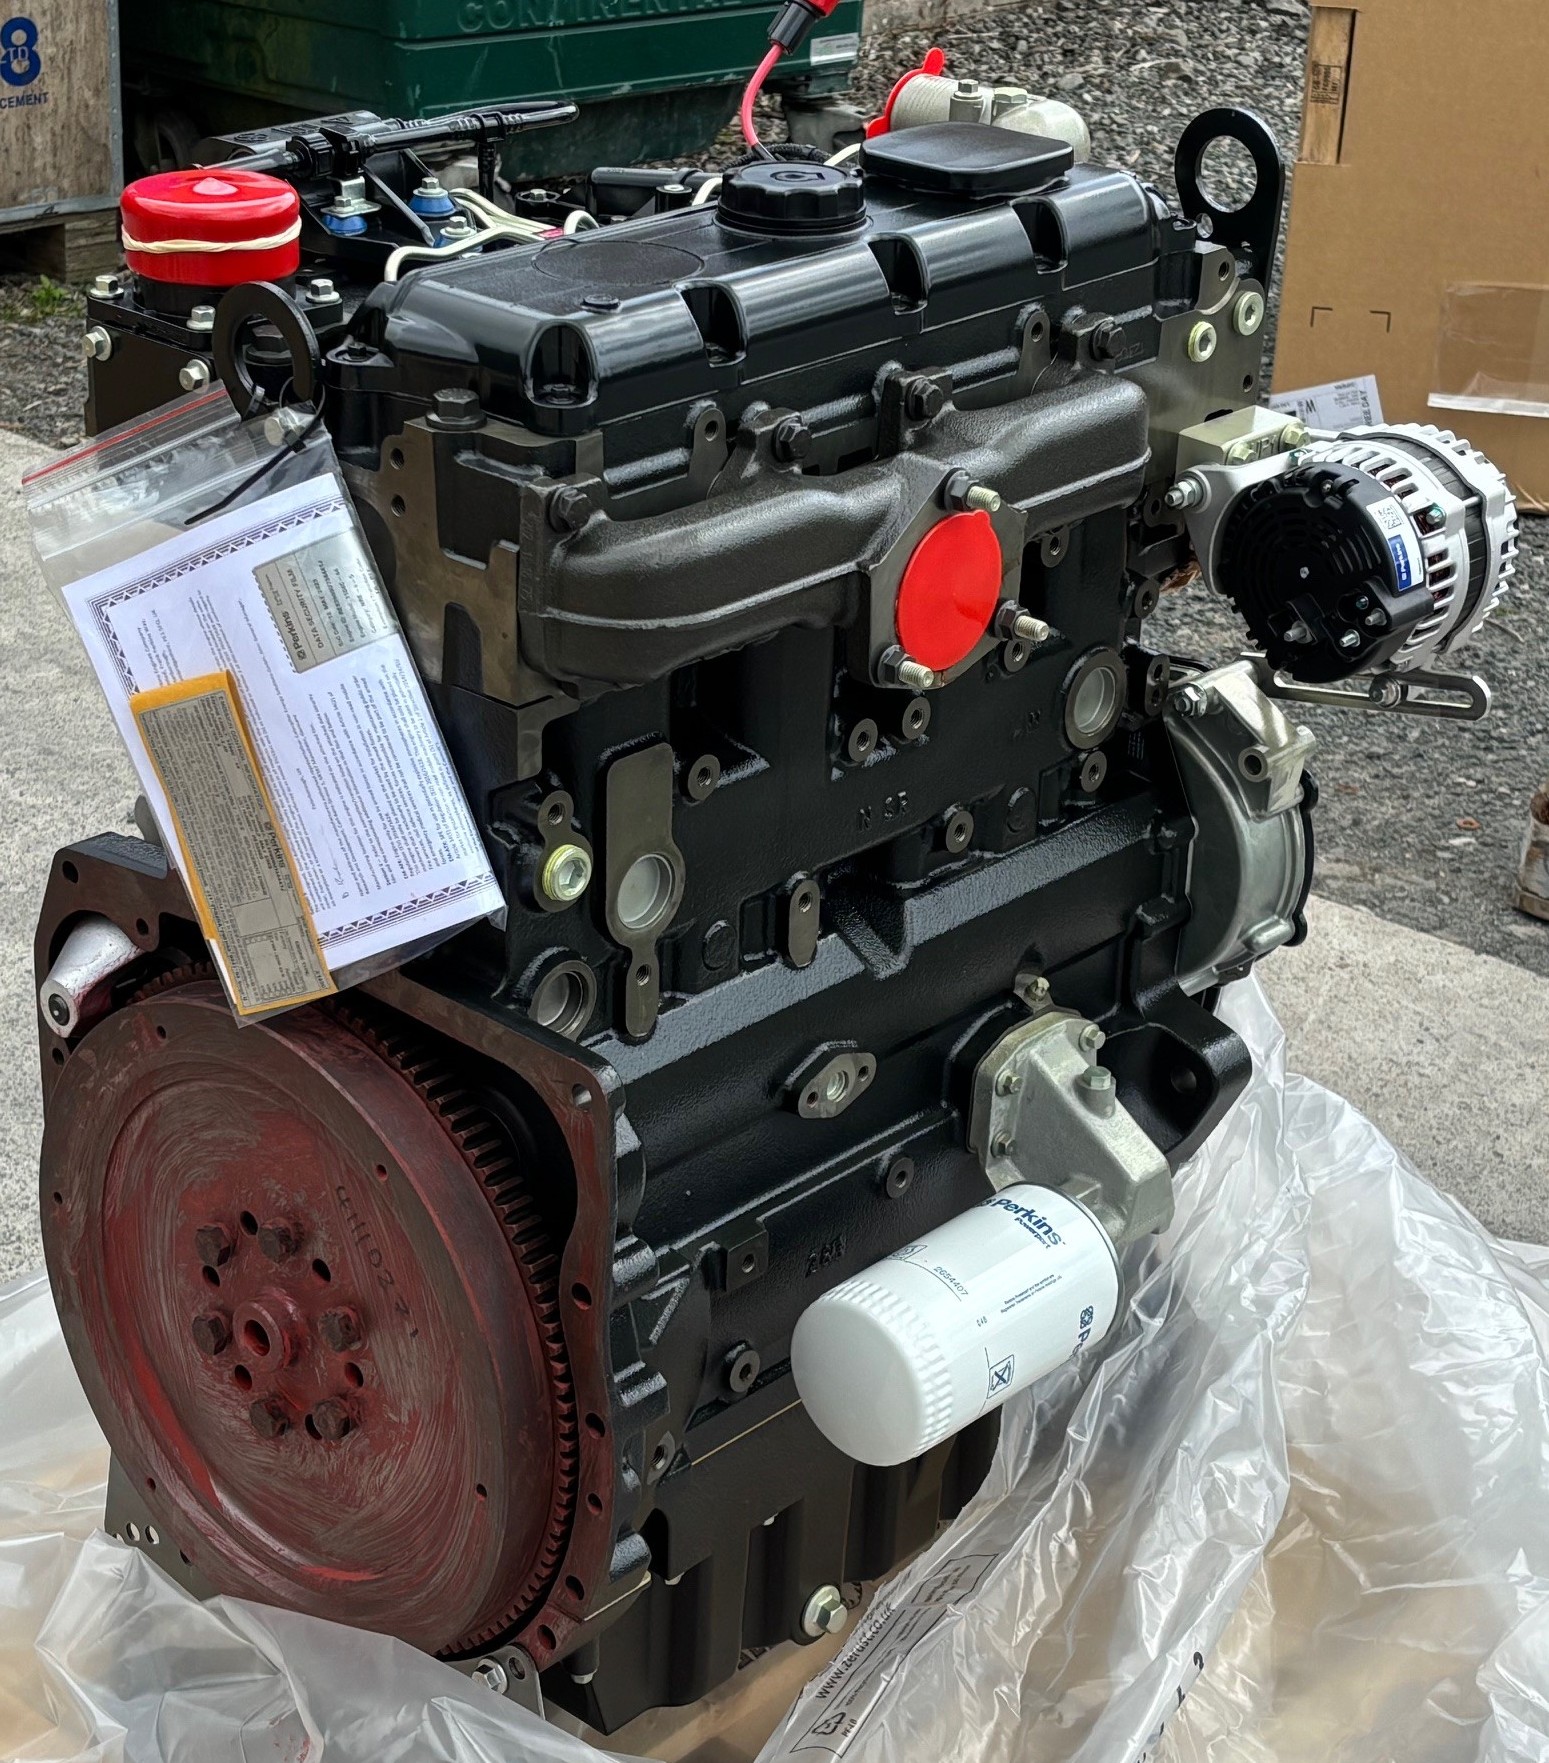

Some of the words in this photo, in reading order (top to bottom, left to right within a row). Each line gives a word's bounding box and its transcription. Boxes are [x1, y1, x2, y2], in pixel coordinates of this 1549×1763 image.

[287, 569, 298, 587] FILM
[294, 589, 314, 626] SECURITY
[319, 596, 328, 610] MAY
[282, 611, 302, 649] Perkins
[311, 627, 324, 648] DATA
[355, 620, 366, 638] Engine
[268, 832, 285, 868] Perkins
[991, 1198, 1062, 1246] Perkins
[1014, 1217, 1052, 1249] Powerpart
[932, 1266, 969, 1297] 2654407
